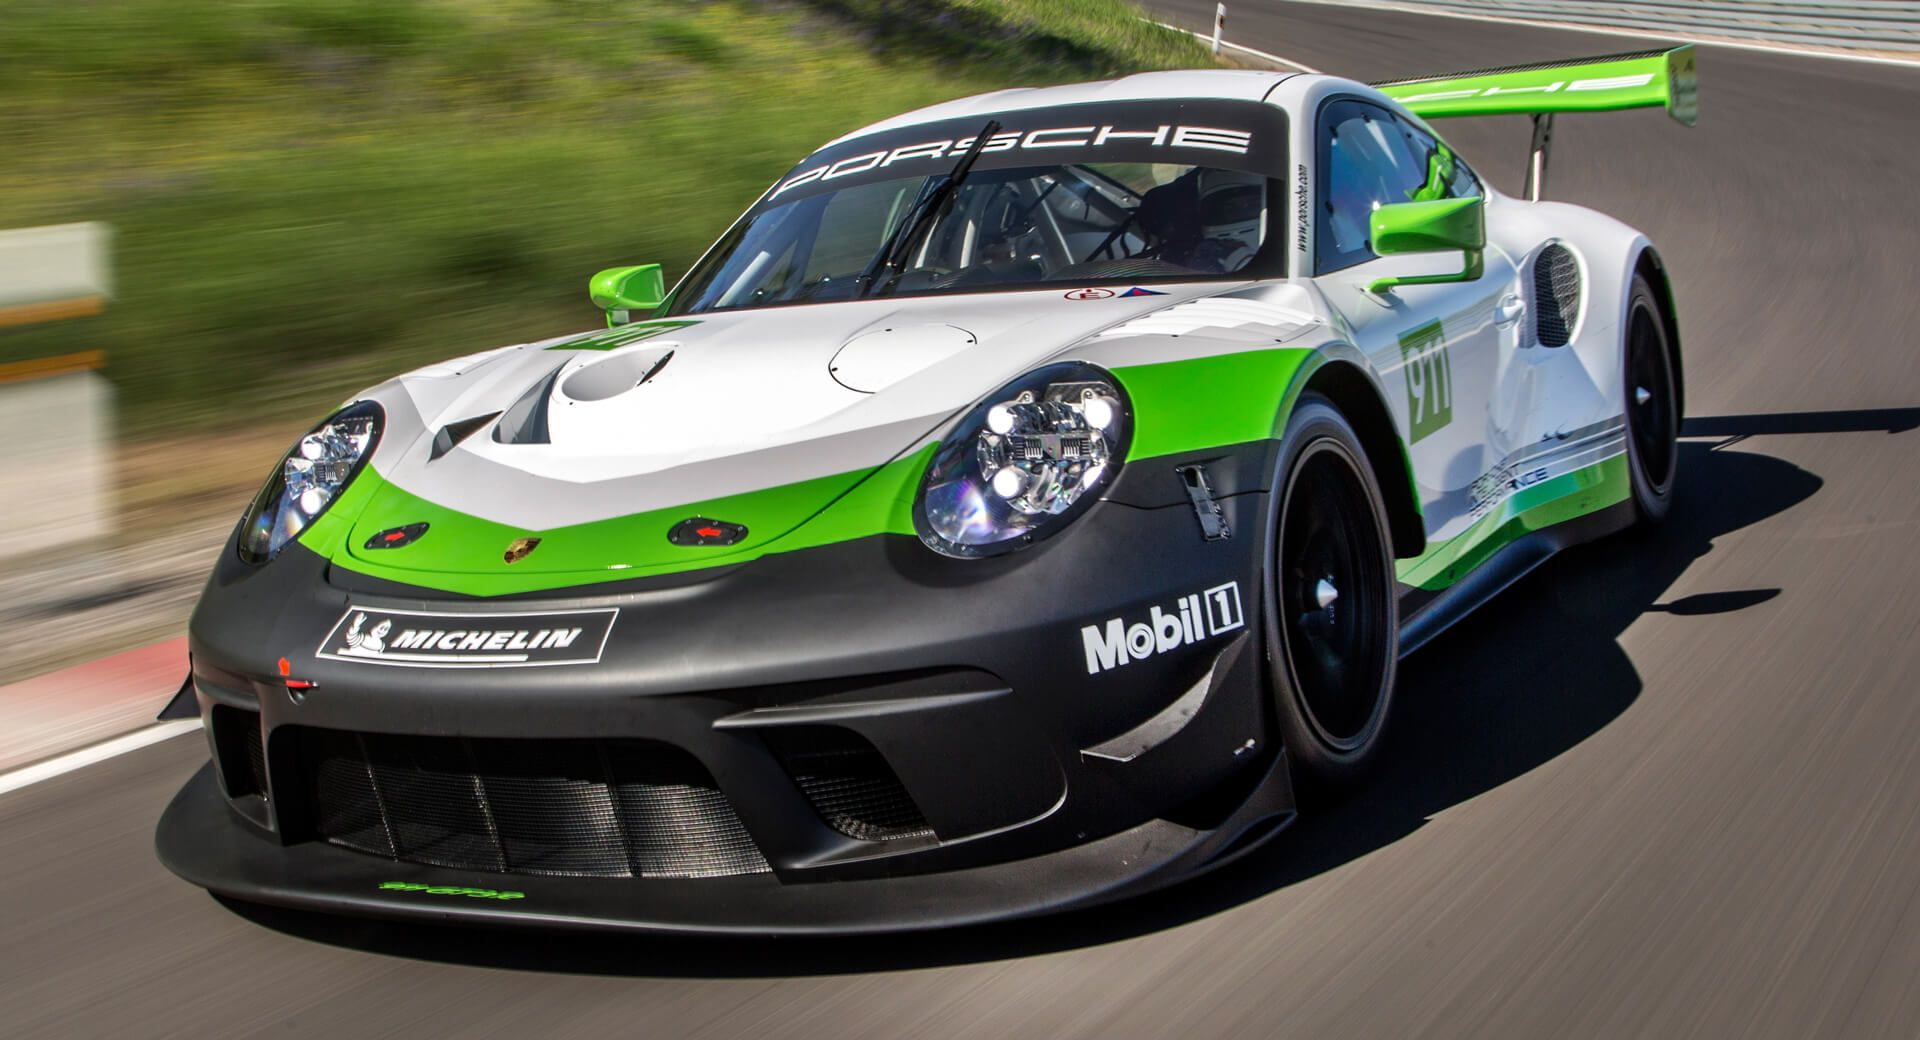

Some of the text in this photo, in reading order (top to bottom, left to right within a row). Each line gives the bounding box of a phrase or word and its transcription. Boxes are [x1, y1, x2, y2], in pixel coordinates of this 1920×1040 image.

[767, 125, 1252, 201] PORSCHE
[1407, 336, 1450, 425] 911
[390, 627, 582, 650] MICHELIN
[1081, 593, 1206, 675] Mobil
